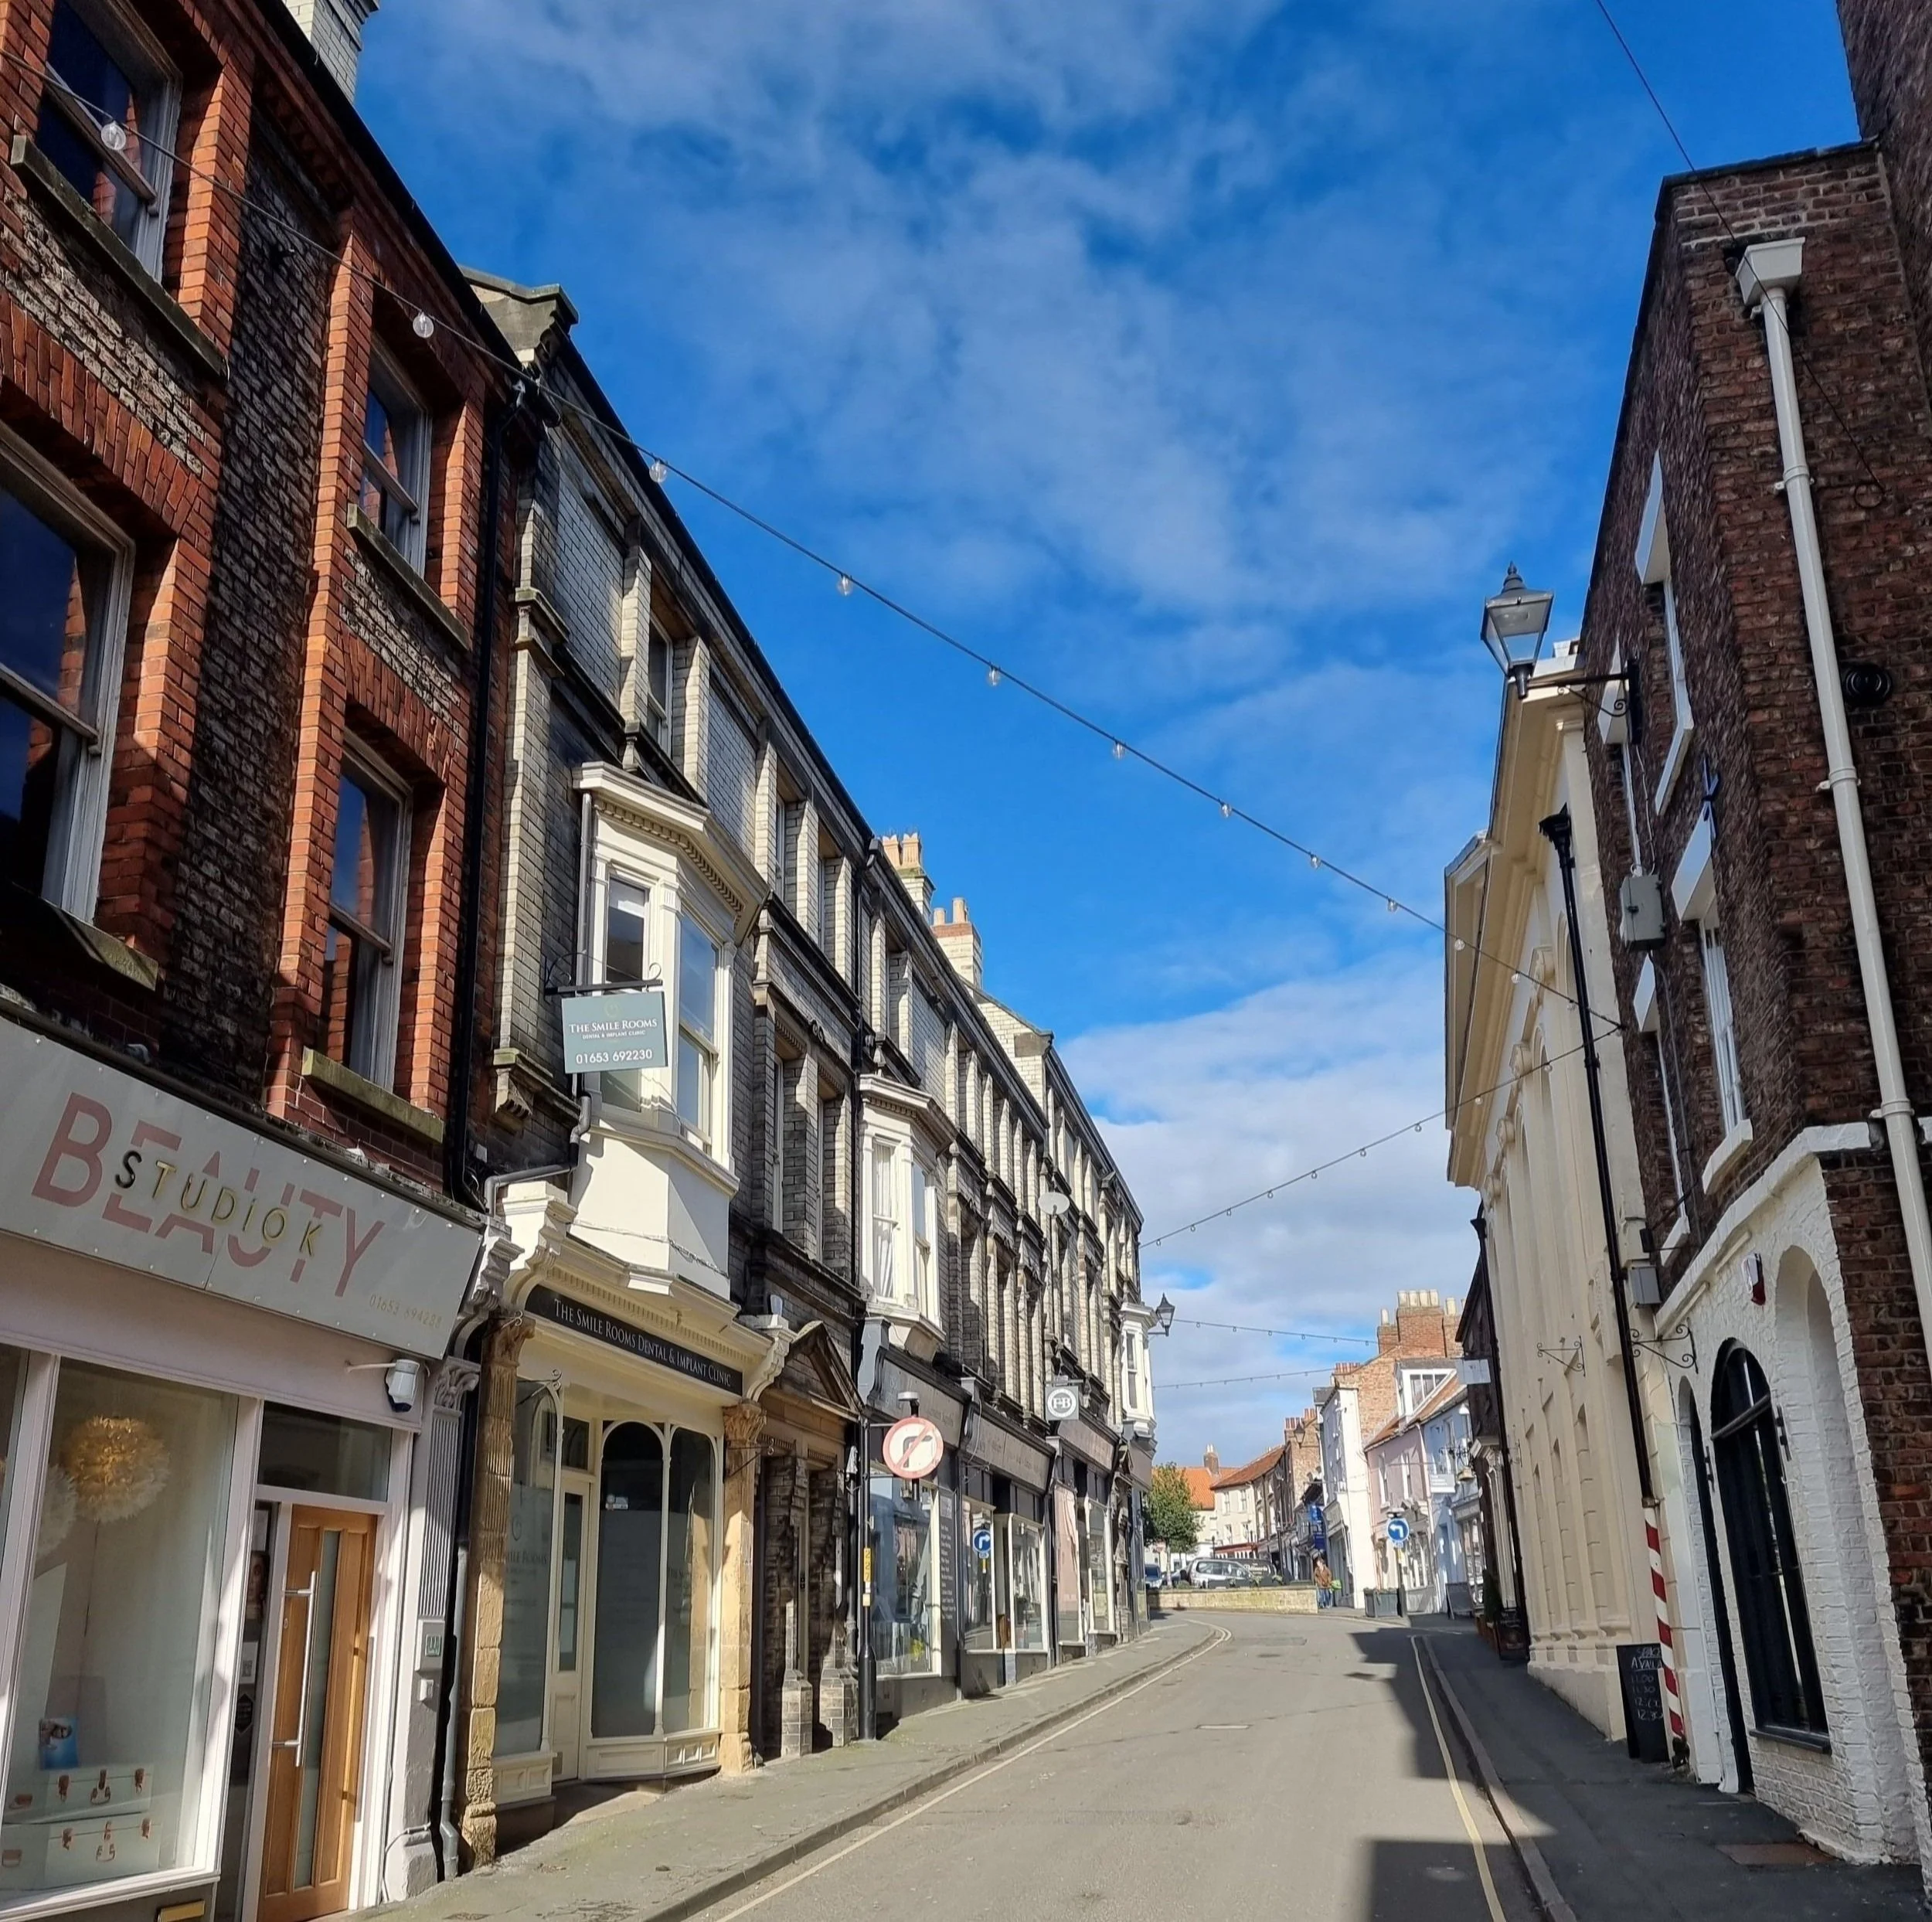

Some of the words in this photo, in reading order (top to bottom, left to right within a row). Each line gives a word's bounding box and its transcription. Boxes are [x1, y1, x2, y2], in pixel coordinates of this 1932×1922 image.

[569, 1024, 590, 1033] THE
[591, 1022, 620, 1032] SMILE
[622, 1019, 657, 1029] ROOMS
[576, 1053, 609, 1064] 01653
[613, 1049, 652, 1062] 692230
[31, 1091, 386, 1297] BEAUTY
[114, 1149, 287, 1243] STUDIO
[554, 1298, 574, 1323] THE
[576, 1308, 603, 1335] SMILE
[605, 1322, 636, 1348] ROOMS
[638, 1335, 667, 1362] DENTAL
[668, 1350, 676, 1365] &
[676, 1351, 708, 1376] IMPLANT
[708, 1364, 732, 1387] CLINIC
